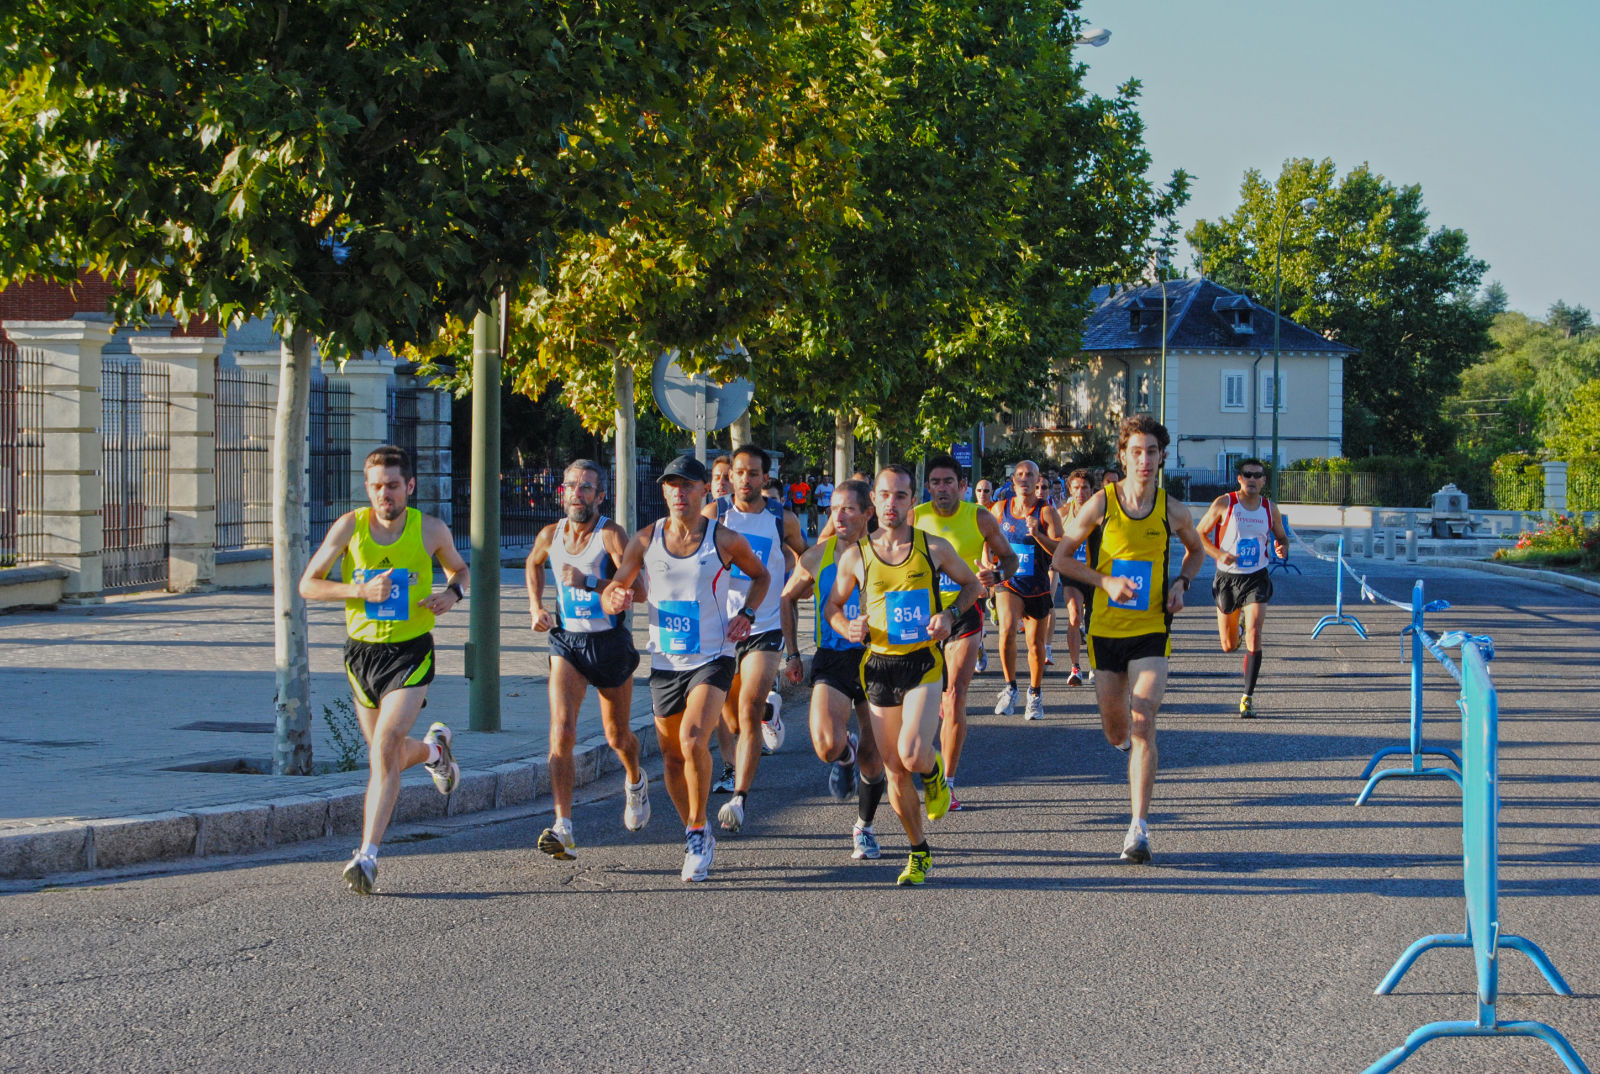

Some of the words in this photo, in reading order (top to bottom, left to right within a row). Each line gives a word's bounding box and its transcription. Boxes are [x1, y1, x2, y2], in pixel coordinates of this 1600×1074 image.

[1240, 546, 1256, 556] 378
[893, 605, 922, 623] 354
[665, 616, 691, 632] 393
